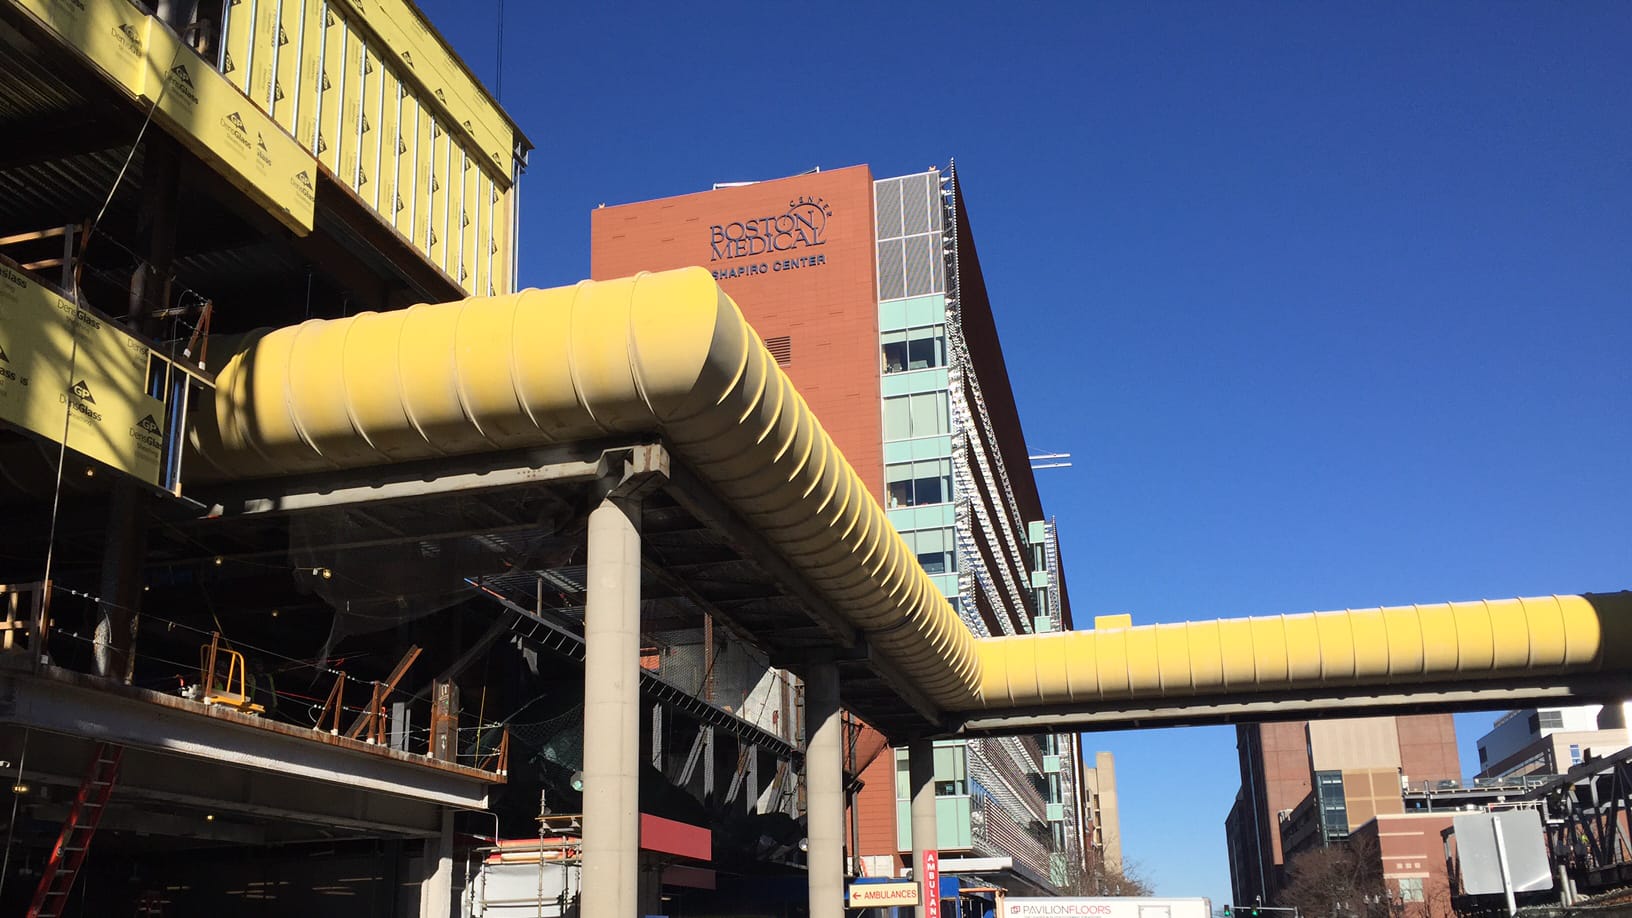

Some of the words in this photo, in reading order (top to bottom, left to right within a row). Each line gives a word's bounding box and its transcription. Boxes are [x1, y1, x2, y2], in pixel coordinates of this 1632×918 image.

[789, 195, 833, 218] CENTER
[709, 209, 815, 244] BOSTON
[710, 226, 826, 262] MEDICAL
[712, 262, 769, 281] SHAPIRO
[772, 253, 826, 273] CENTER
[863, 889, 917, 900] AMBULANCES
[926, 853, 937, 918] AMBULAN
